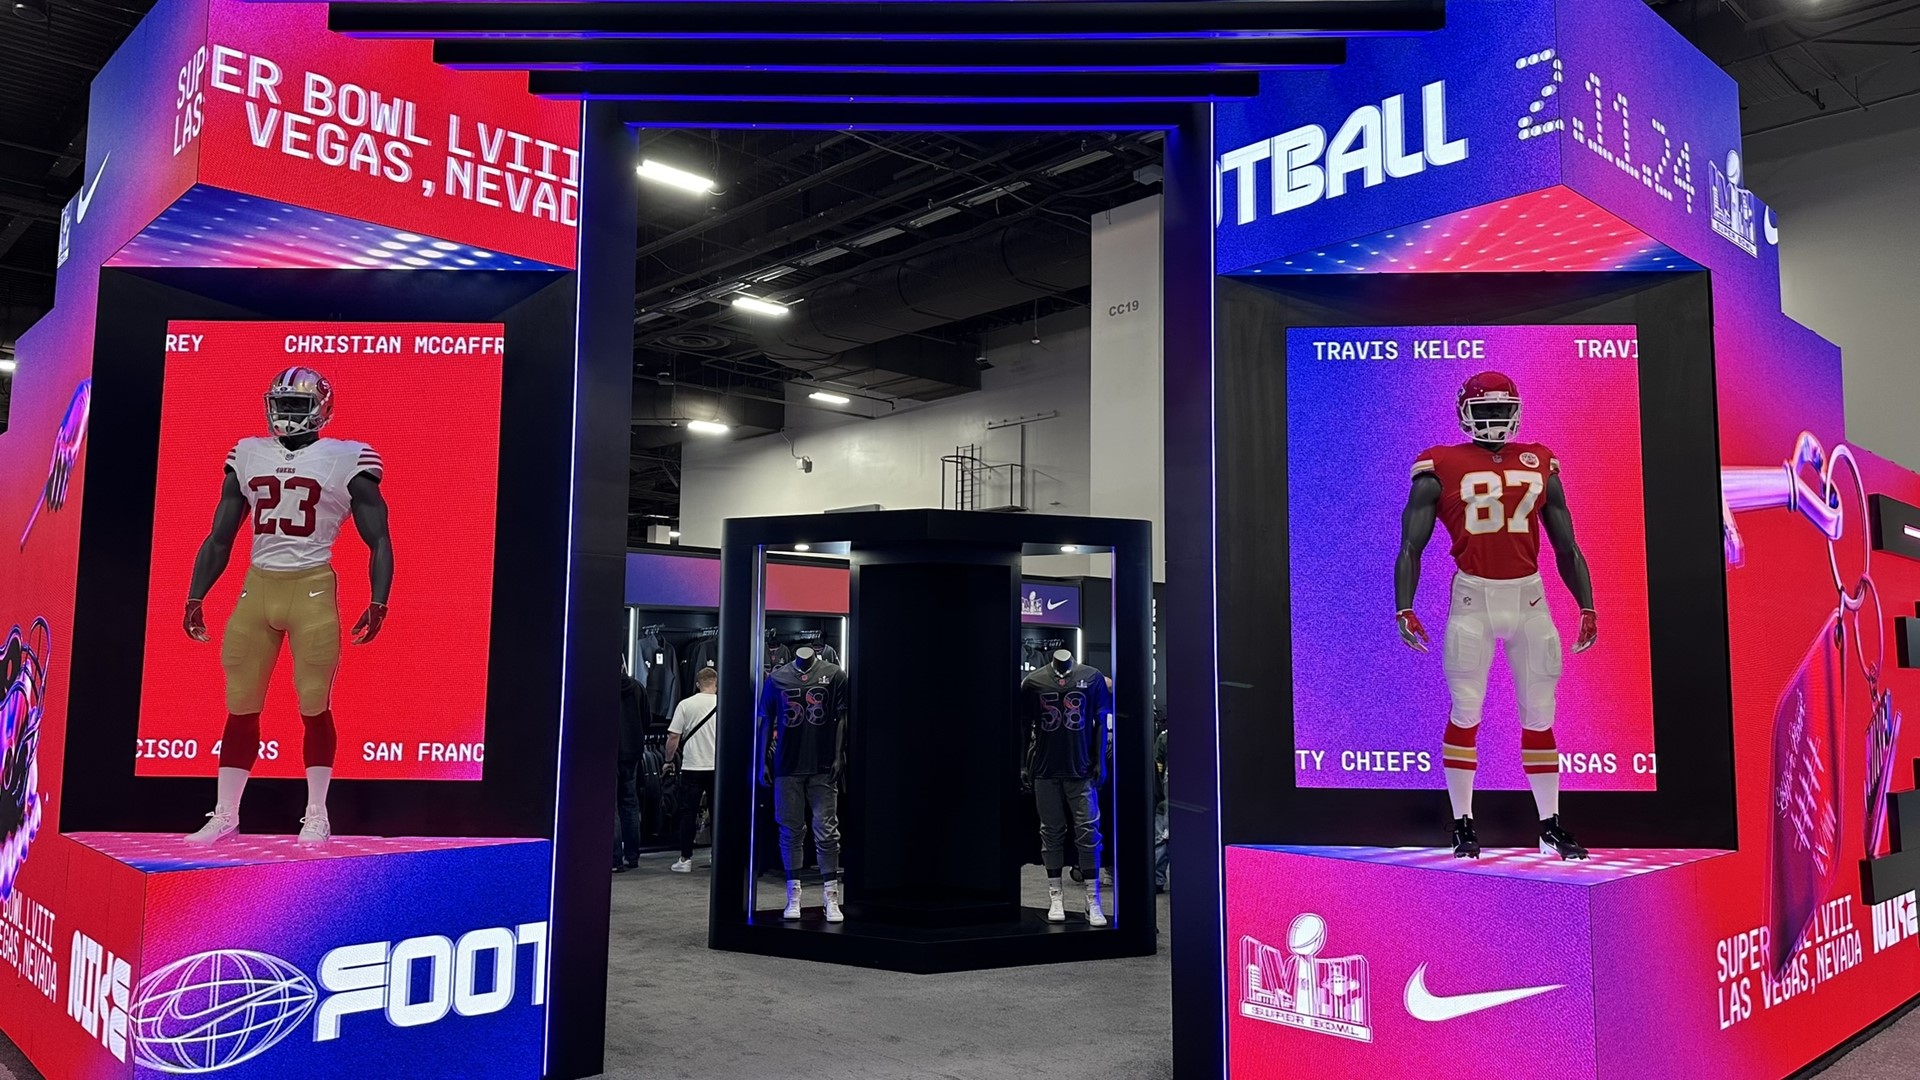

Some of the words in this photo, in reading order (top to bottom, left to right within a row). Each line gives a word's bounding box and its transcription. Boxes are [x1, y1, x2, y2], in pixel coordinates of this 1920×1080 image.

[173, 92, 206, 157] LAS
[303, 71, 432, 146] BOWL
[449, 114, 579, 188] LVIII
[1216, 79, 1469, 228] TBALL
[1108, 299, 1140, 317] CC19
[165, 334, 204, 352] REY
[284, 335, 402, 353] CHRISTIAN
[414, 336, 505, 355] MCCAFFR
[1313, 341, 1399, 360] TRAVIS
[1413, 340, 1486, 359] KELCE
[248, 475, 322, 537] 23
[1460, 469, 1543, 534] 87
[780, 686, 830, 728] 58
[1039, 690, 1087, 732] 58
[211, 740, 279, 760] 4RS
[362, 742, 403, 761] SAN
[418, 743, 485, 762] FRANC
[1295, 750, 1325, 770] TY
[1341, 751, 1431, 772] CHIEFS
[1558, 752, 1617, 774] NSAS
[25, 897, 56, 954] LVIII
[313, 920, 547, 1043] FOOT
[1251, 1006, 1305, 1026] SUPER
[1718, 977, 1752, 1030] LAS
